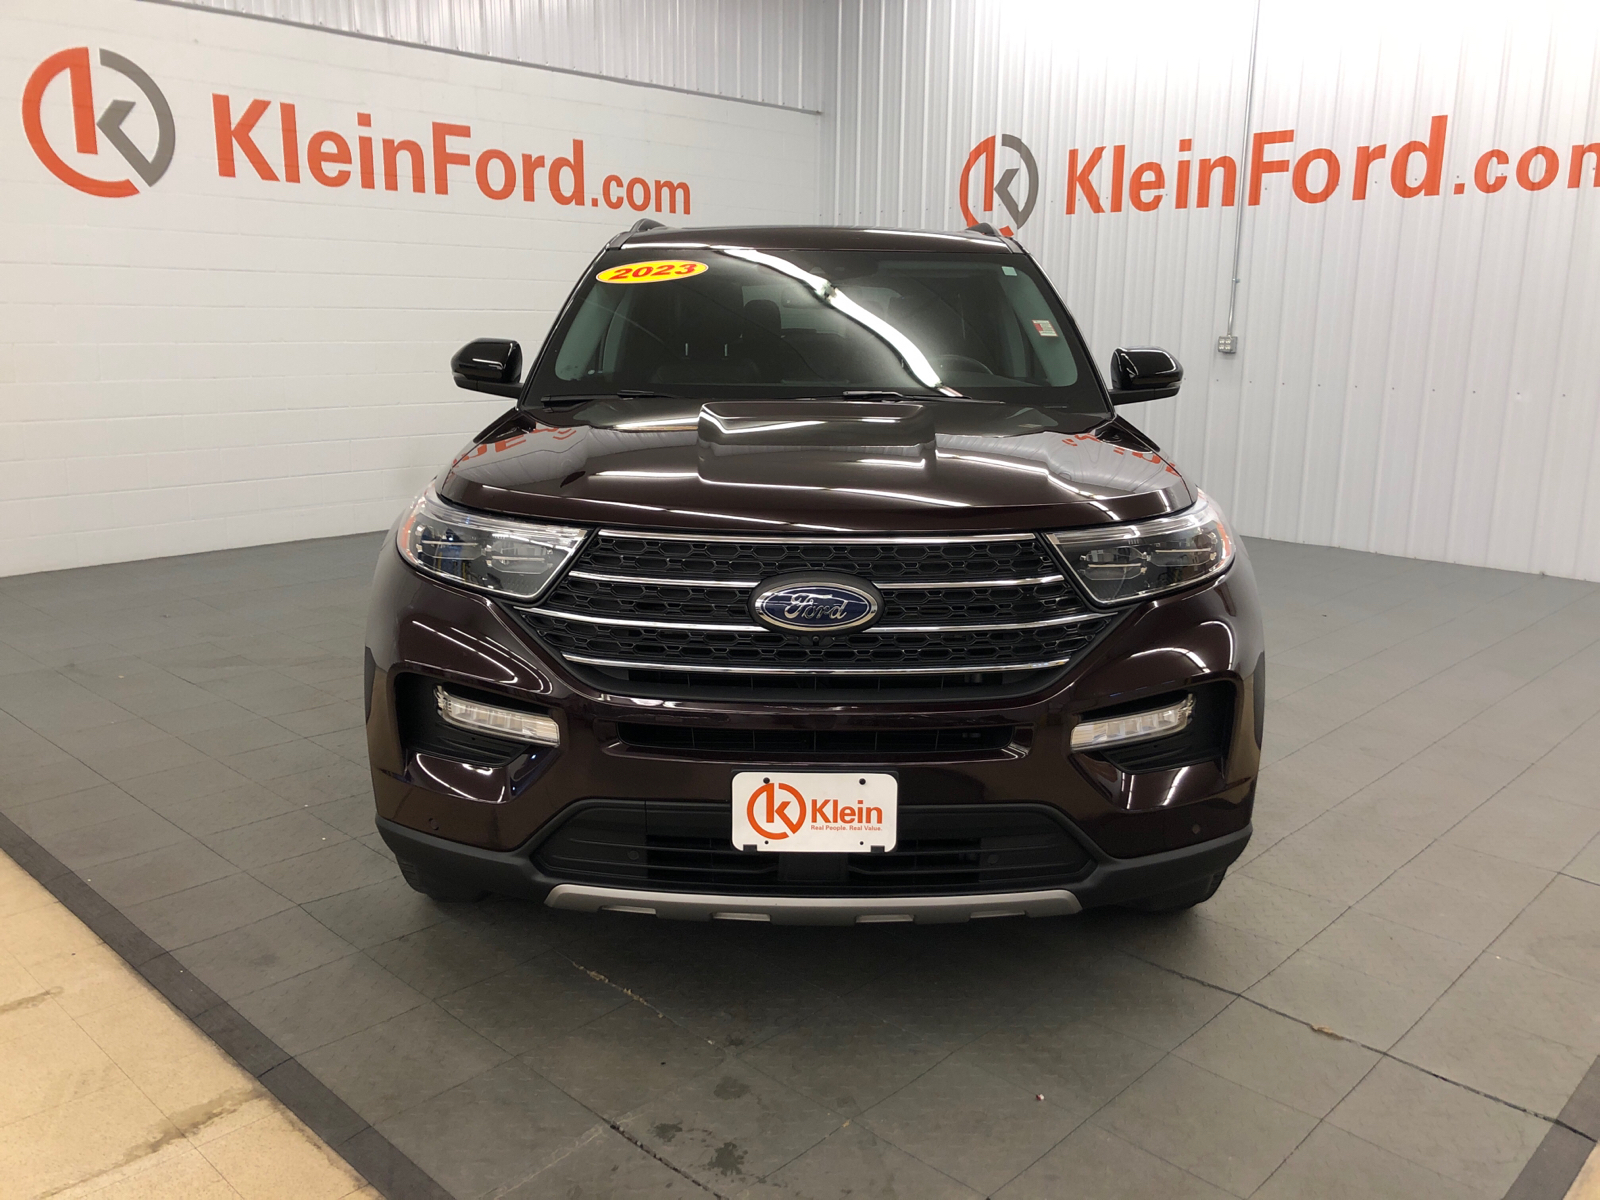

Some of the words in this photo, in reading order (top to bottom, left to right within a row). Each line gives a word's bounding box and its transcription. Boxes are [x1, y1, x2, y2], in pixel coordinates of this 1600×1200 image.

[211, 92, 691, 216] KleinFord.com
[608, 263, 698, 280] 2023
[784, 592, 848, 619] Ford
[810, 798, 883, 824] Klein
[825, 824, 847, 832] People.
